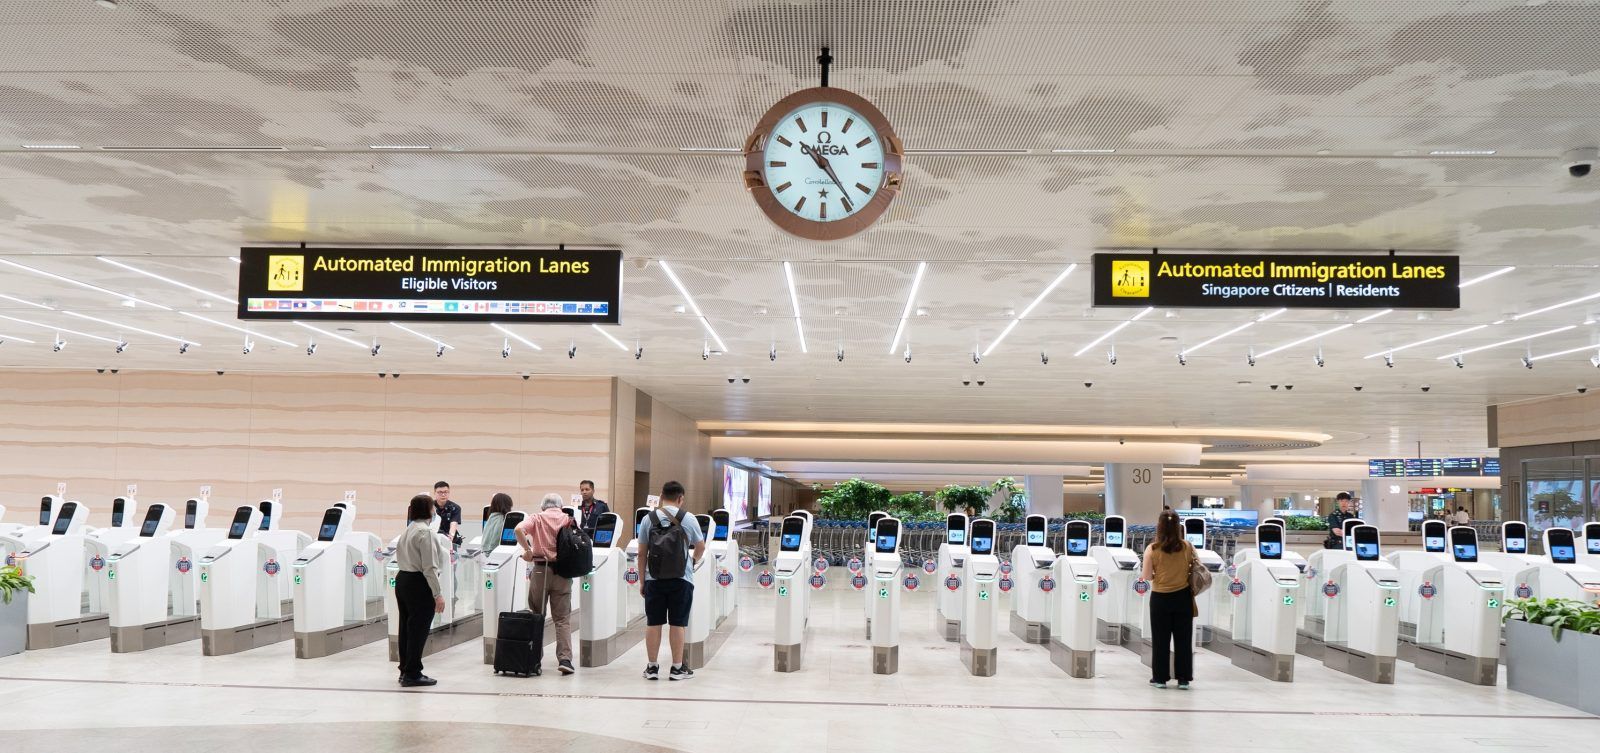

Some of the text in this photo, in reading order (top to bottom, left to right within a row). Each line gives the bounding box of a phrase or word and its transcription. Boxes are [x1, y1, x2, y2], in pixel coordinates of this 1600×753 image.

[313, 255, 414, 272] Automated
[421, 256, 531, 277] Immigration
[539, 257, 590, 274] Lanes
[1156, 261, 1265, 278] Automated
[1270, 262, 1387, 283] Immigration
[1392, 263, 1446, 279] Lanes
[401, 277, 498, 293] Eligible Visitors
[1201, 283, 1270, 299] Singapore
[1272, 284, 1326, 297] Citizens
[1336, 284, 1401, 297] Residents
[1132, 468, 1152, 484] 30
